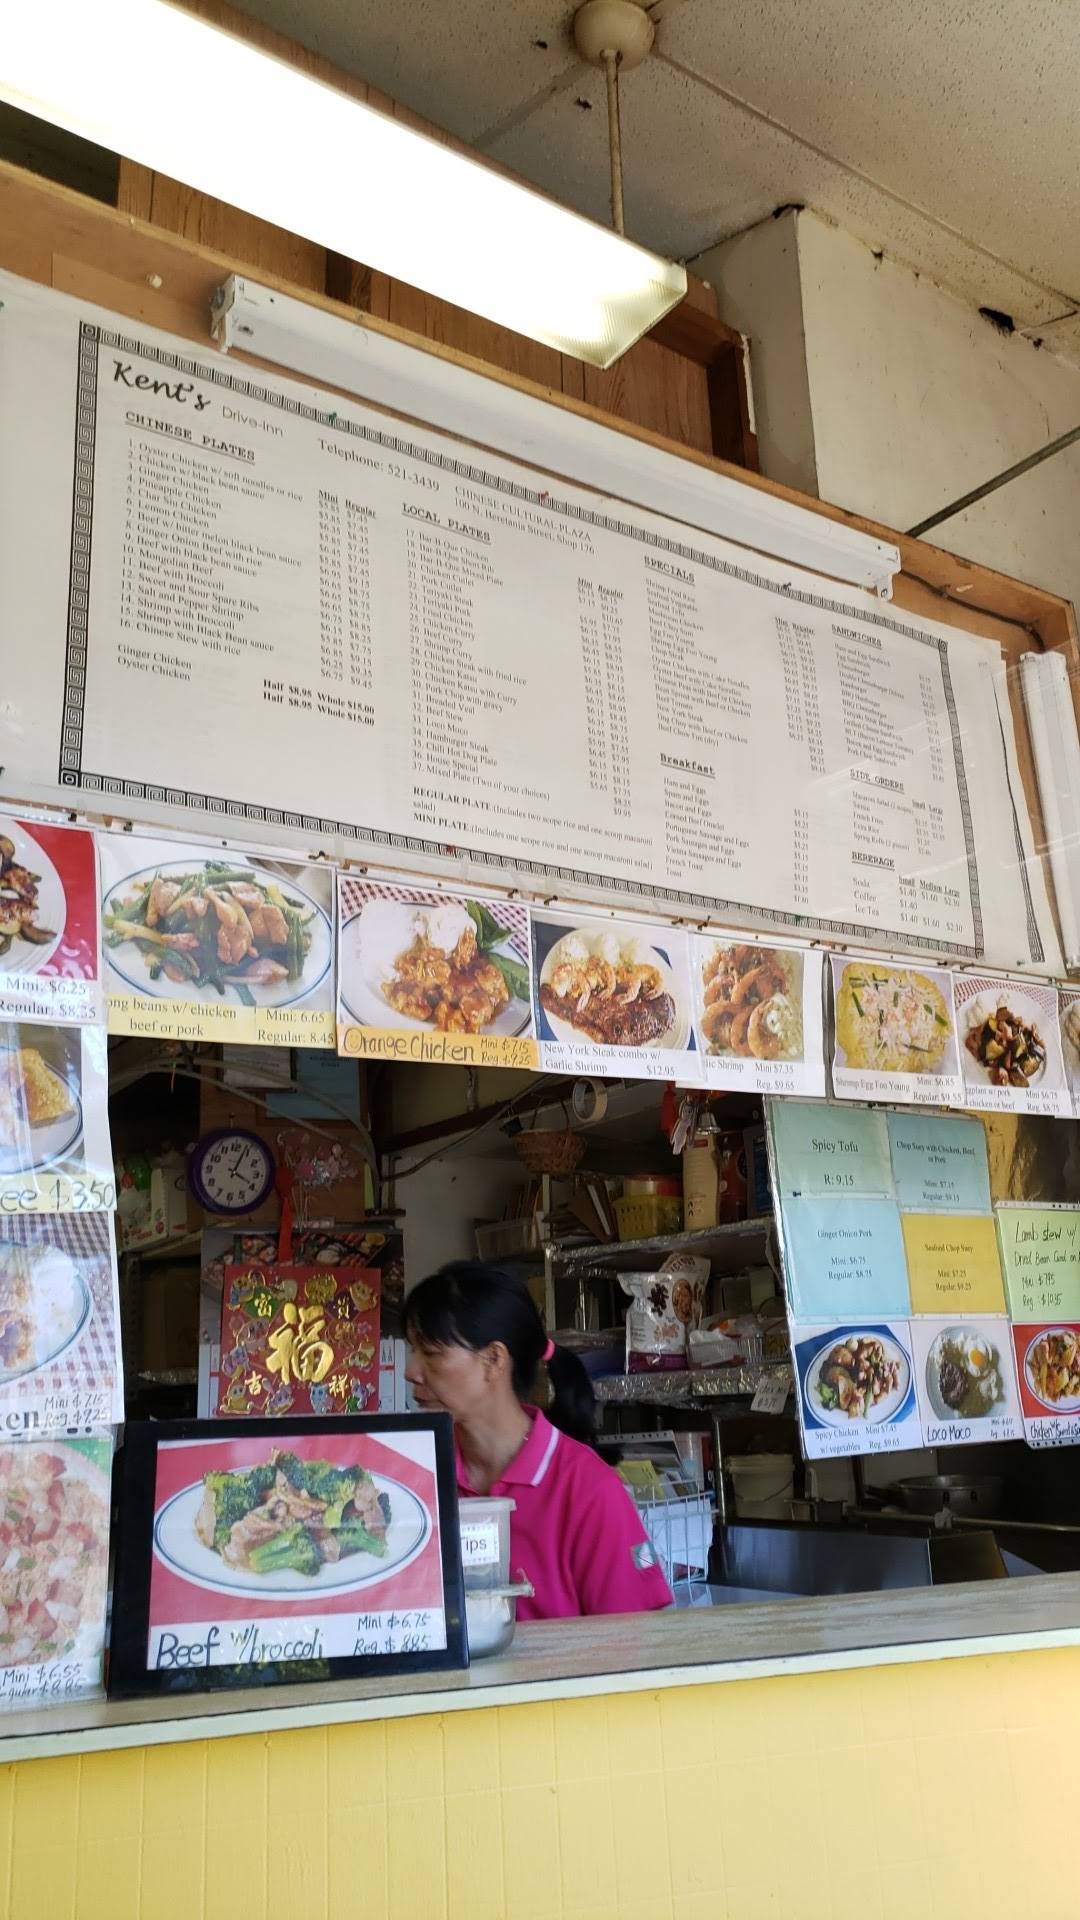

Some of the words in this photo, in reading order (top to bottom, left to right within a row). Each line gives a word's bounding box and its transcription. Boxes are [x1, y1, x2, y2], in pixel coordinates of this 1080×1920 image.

[112, 359, 211, 411] Kent's
[222, 404, 282, 437] Drive-Inn
[125, 411, 191, 440] CHINESE
[202, 434, 254, 460] PLATES
[318, 437, 383, 471] Telephone:
[388, 463, 439, 491] 521-3439
[138, 464, 169, 482] Ginger
[172, 475, 208, 494] Chicken
[139, 476, 182, 497] Pineapple
[184, 490, 221, 509] Chicken
[318, 489, 337, 504] Mini
[345, 498, 375, 518] Regular
[138, 499, 169, 516] Lemon
[172, 509, 208, 528] Chicken
[402, 502, 440, 525] LOCAL
[447, 518, 490, 541] PLATES
[455, 485, 499, 509] CHINESE
[501, 503, 560, 531] CULTURAL
[560, 522, 591, 542] PLAZA
[139, 547, 188, 570] Mongolian
[192, 562, 212, 576] Beef
[643, 555, 694, 583] SPECIALS
[139, 559, 161, 574] Beef
[163, 568, 183, 580] with
[186, 572, 223, 591] Broccoli
[137, 596, 171, 615] Shrimp
[174, 607, 194, 619] with
[197, 612, 234, 630] Broccoli
[136, 608, 171, 627] Shrimp
[173, 620, 193, 631] with
[196, 623, 221, 639] Black
[225, 631, 247, 645] Bean
[250, 639, 273, 651] sauce
[831, 623, 882, 649] SANDWICHES
[117, 643, 149, 659] Ginger
[153, 652, 191, 669] Chicken
[117, 655, 149, 671] Oyster
[151, 663, 190, 680] Chicken
[263, 679, 283, 691] Half
[288, 685, 311, 697] $8.95
[317, 691, 344, 706] Whole
[347, 700, 374, 714] $15.00
[263, 691, 282, 703] Half
[288, 697, 312, 709] $8.95
[317, 704, 344, 718] Whole
[347, 711, 374, 726] $15.00
[660, 752, 714, 775] Breakfast
[850, 768, 870, 782] SIDE
[874, 775, 903, 790] ORDERS
[413, 786, 459, 803] REGULAR
[462, 796, 488, 810] PLATE
[6, 977, 44, 992] Mini:
[49, 980, 86, 995] $6.25
[132, 998, 168, 1012] beans
[172, 1002, 188, 1015] w/
[190, 1003, 237, 1019] chicken
[266, 1009, 297, 1023] Mini:
[300, 1011, 325, 1023] 6.65
[130, 1018, 157, 1032] beef
[160, 1024, 173, 1033] or
[177, 1024, 204, 1037] pork
[257, 1029, 306, 1045] Regular:
[310, 1031, 334, 1044] 8.45
[343, 1027, 407, 1058] Orange
[410, 1032, 475, 1062] Chicken
[480, 1038, 498, 1049] Mini
[501, 1040, 531, 1053] $7.15
[544, 1043, 565, 1055] New
[568, 1044, 589, 1056] York
[592, 1046, 616, 1058] Steak
[618, 1049, 647, 1060] combo
[650, 1051, 661, 1061] w/
[503, 1052, 532, 1066] $9.25
[545, 1060, 572, 1070] Garlic
[575, 1061, 608, 1074] Shrimp
[646, 1065, 675, 1076] $12.95
[755, 1063, 772, 1073] Mini
[756, 1079, 773, 1090] Reg.
[774, 1081, 795, 1090] $9.65
[860, 1080, 873, 1091] Egg
[875, 1081, 888, 1089] Foo
[889, 1081, 910, 1092] Young
[811, 1138, 836, 1153] Spicy
[838, 1140, 858, 1152] Tofu
[824, 1173, 834, 1185] R:
[836, 1174, 854, 1186] 9.15
[48, 1178, 116, 1211] $3.50
[1015, 1221, 1038, 1243] Lamb
[1043, 1220, 1061, 1241] stew
[254, 1292, 273, 1318] 富
[265, 1302, 335, 1386] 福
[244, 1369, 263, 1396] 吉
[328, 1373, 349, 1400] 祥
[45, 1396, 69, 1411] Mini
[815, 1430, 832, 1441] Spicy
[833, 1428, 859, 1439] Chicken
[865, 1425, 879, 1434] Mini
[880, 1424, 897, 1433] $7.45
[927, 1425, 947, 1443] Loco
[949, 1425, 971, 1441] Moco
[829, 1443, 860, 1454] vegetables
[357, 1615, 382, 1632] Mini
[387, 1613, 432, 1630] $6.75
[156, 1626, 220, 1668] Beef
[353, 1638, 383, 1658] Reg.
[3, 1667, 30, 1686] Mini
